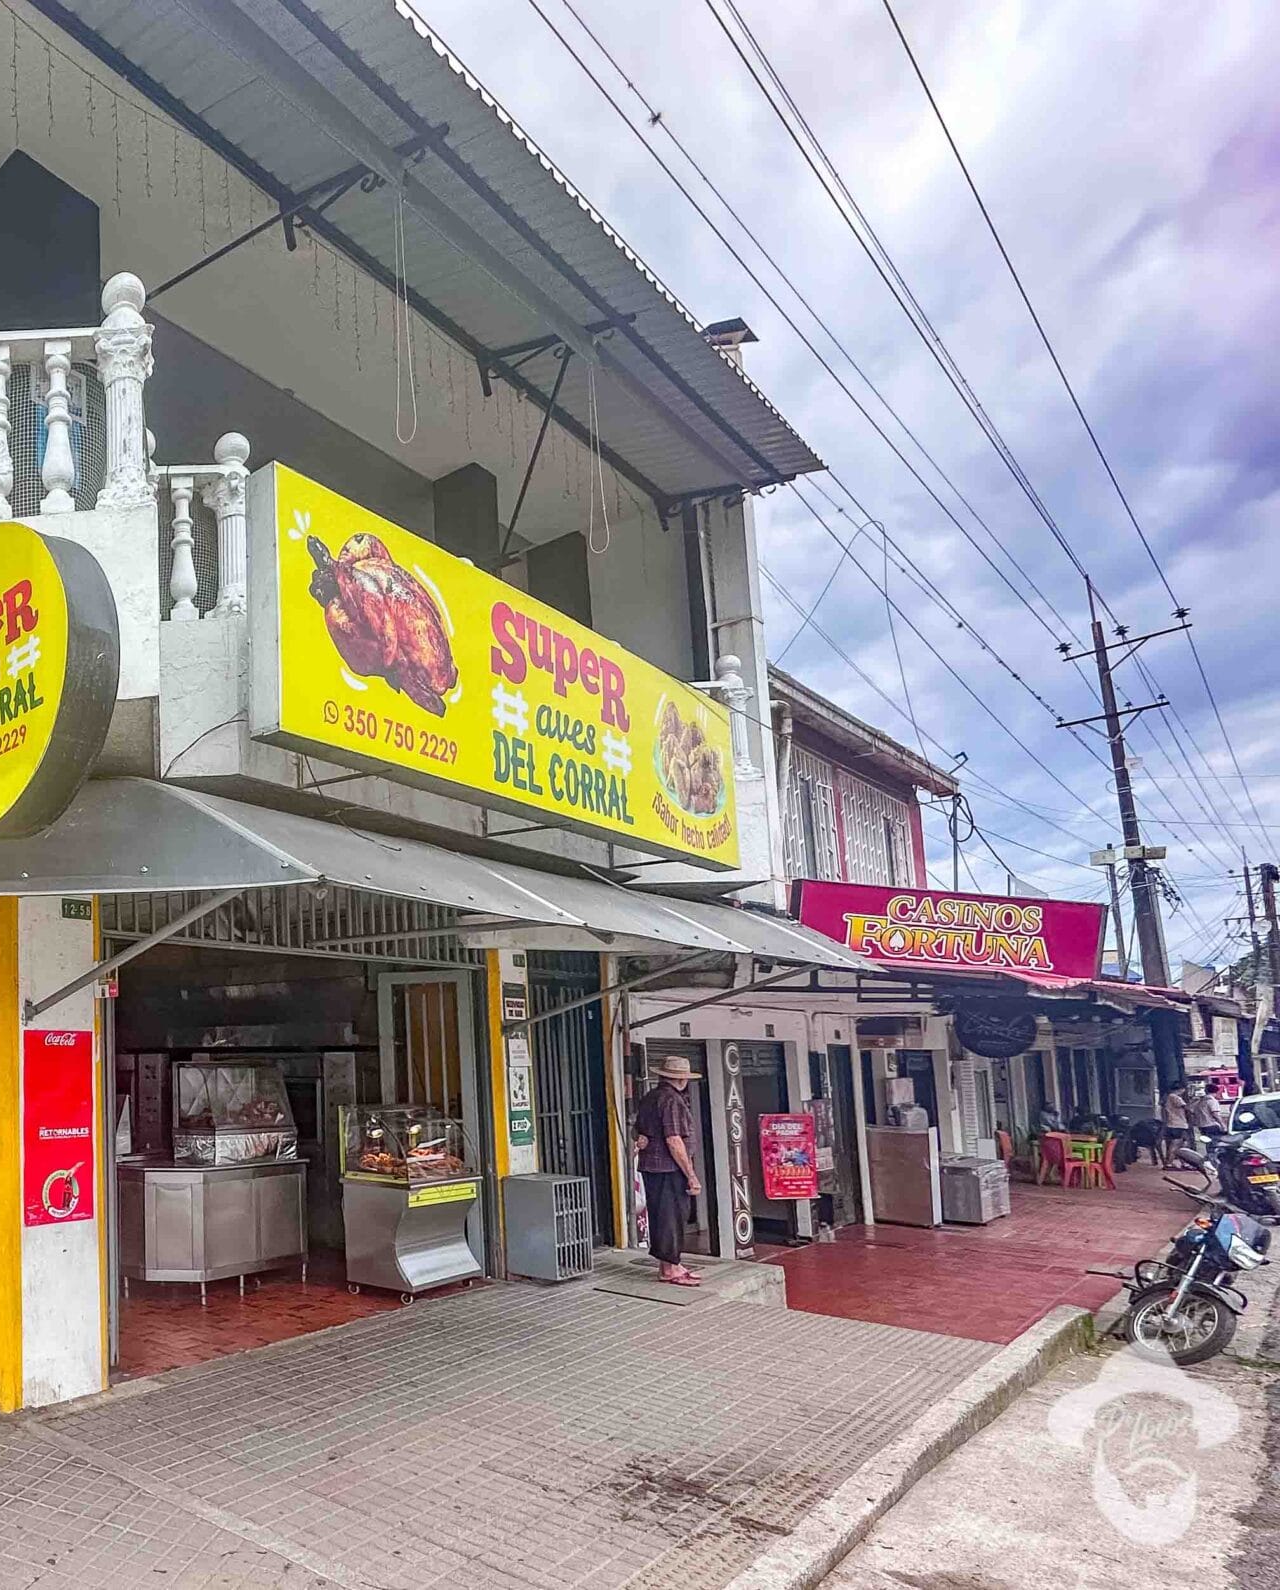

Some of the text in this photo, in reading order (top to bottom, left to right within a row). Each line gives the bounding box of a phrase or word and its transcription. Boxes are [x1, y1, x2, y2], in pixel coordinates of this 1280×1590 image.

[343, 704, 458, 765] 350 750 2229
[535, 703, 597, 756] aves
[492, 730, 634, 826] DEL CORRAL
[651, 791, 733, 850] ¡Sabor hecho calidad!
[63, 903, 91, 917] 12-58
[888, 896, 1042, 934] CASINOS
[844, 914, 1053, 969] FORTUNA
[39, 1127, 89, 1138] RETORNABLES
[725, 1042, 754, 1244] CASINO
